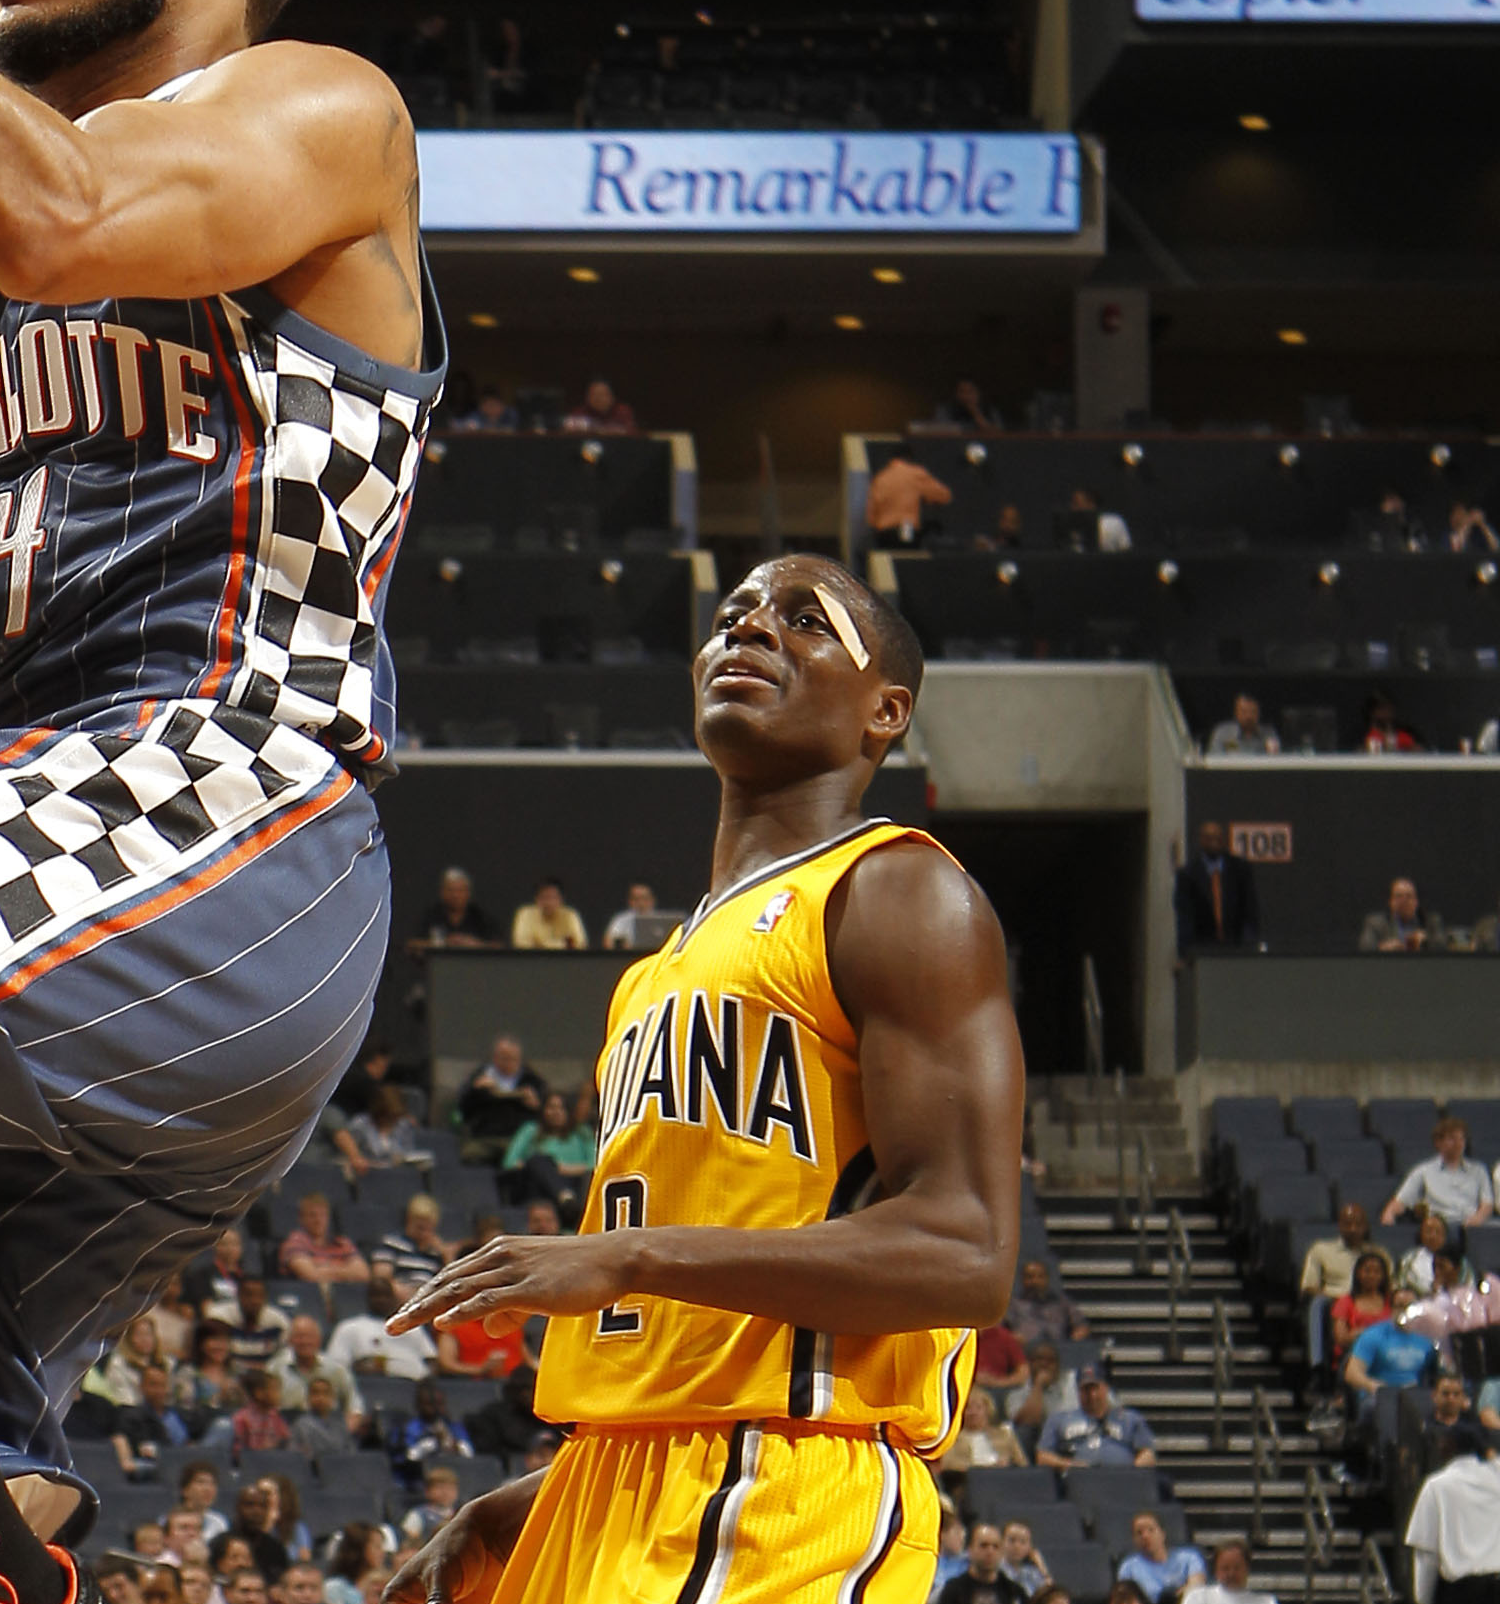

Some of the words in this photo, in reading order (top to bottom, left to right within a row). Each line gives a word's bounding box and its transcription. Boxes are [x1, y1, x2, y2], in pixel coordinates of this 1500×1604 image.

[584, 139, 1016, 218] Remarkable
[1238, 831, 1286, 858] 108
[596, 989, 819, 1167] DIANA
